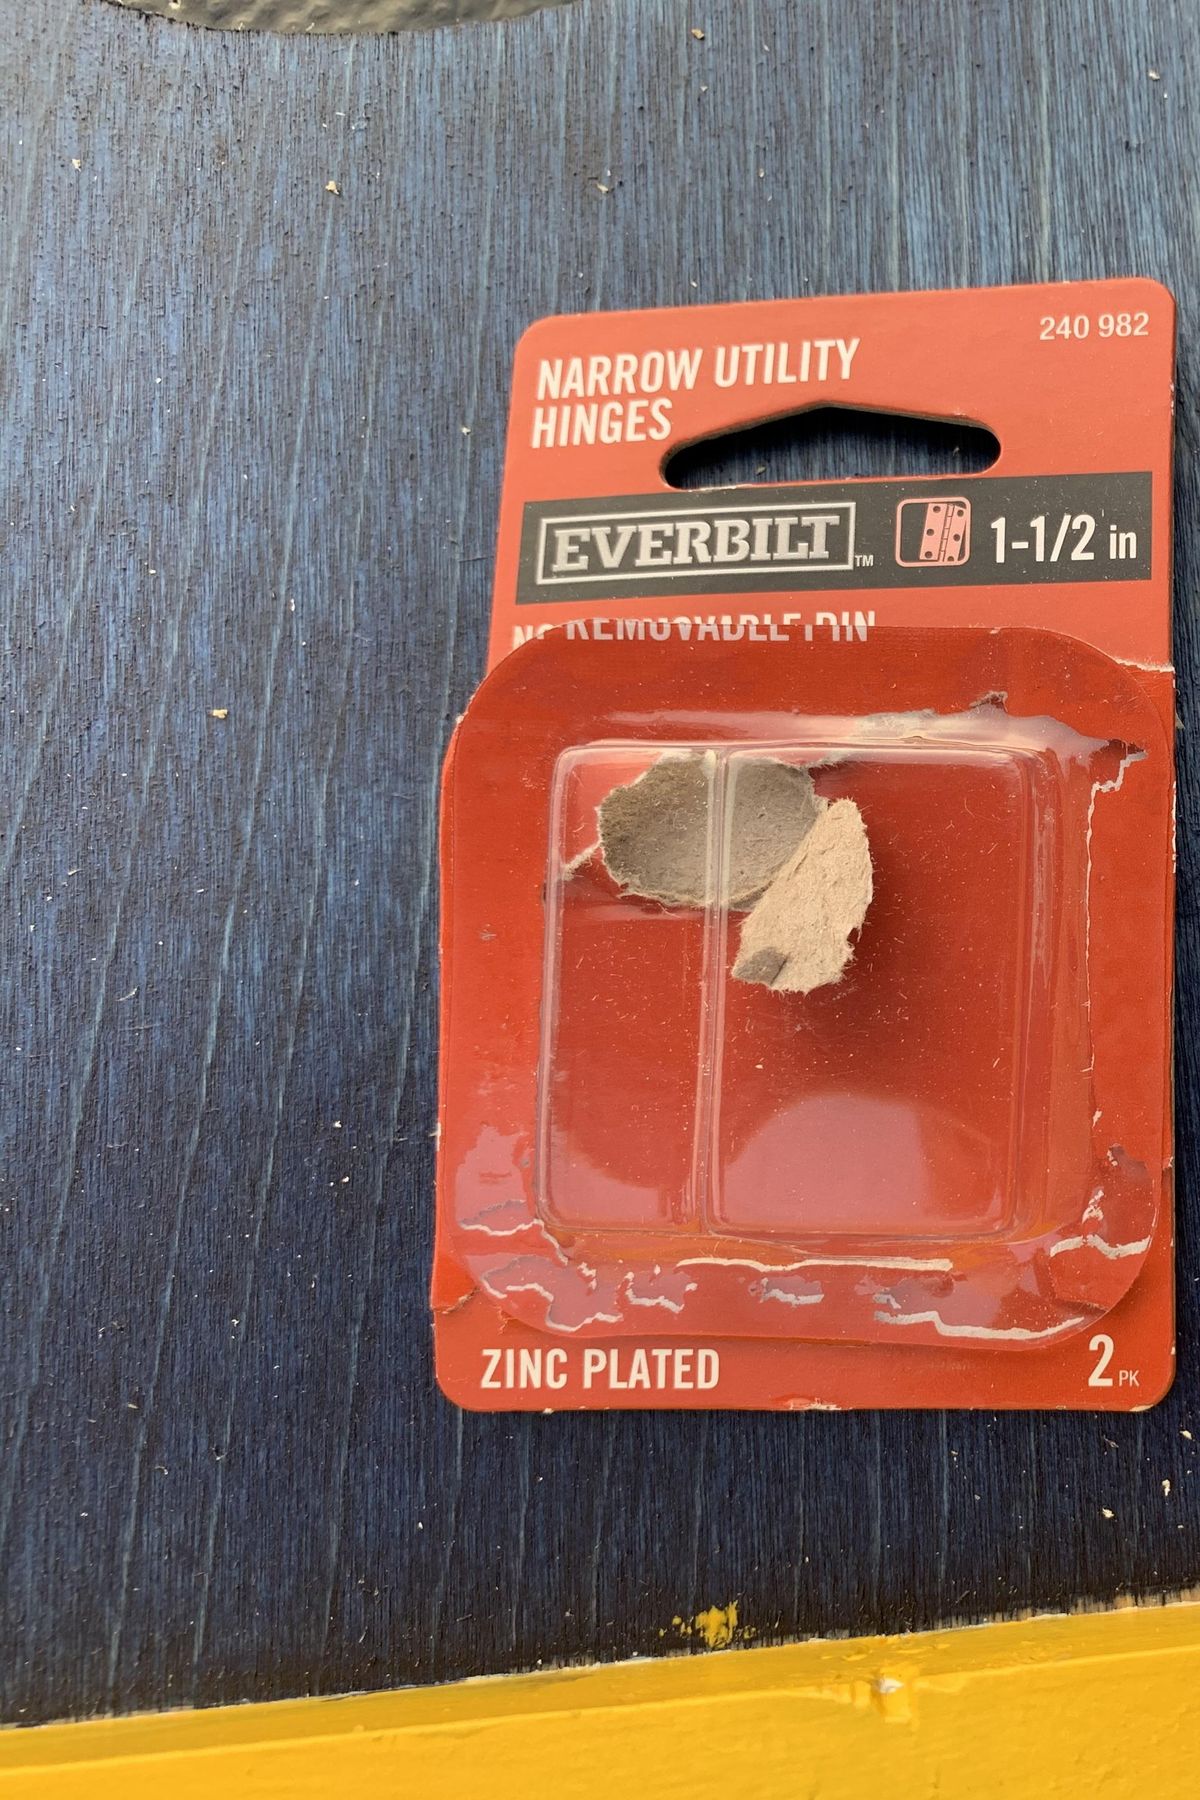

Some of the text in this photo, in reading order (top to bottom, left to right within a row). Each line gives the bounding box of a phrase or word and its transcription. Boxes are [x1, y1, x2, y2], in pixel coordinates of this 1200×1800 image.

[1038, 312, 1150, 341] 240 982
[536, 337, 861, 401] NARROW UTILITY
[530, 397, 673, 449] HINGES
[551, 514, 875, 573] EVERBILT TM
[990, 514, 1138, 564] 1-1/2 in
[480, 1347, 721, 1390] ZINC PLATED
[1088, 1333, 1140, 1388] 2 PK
